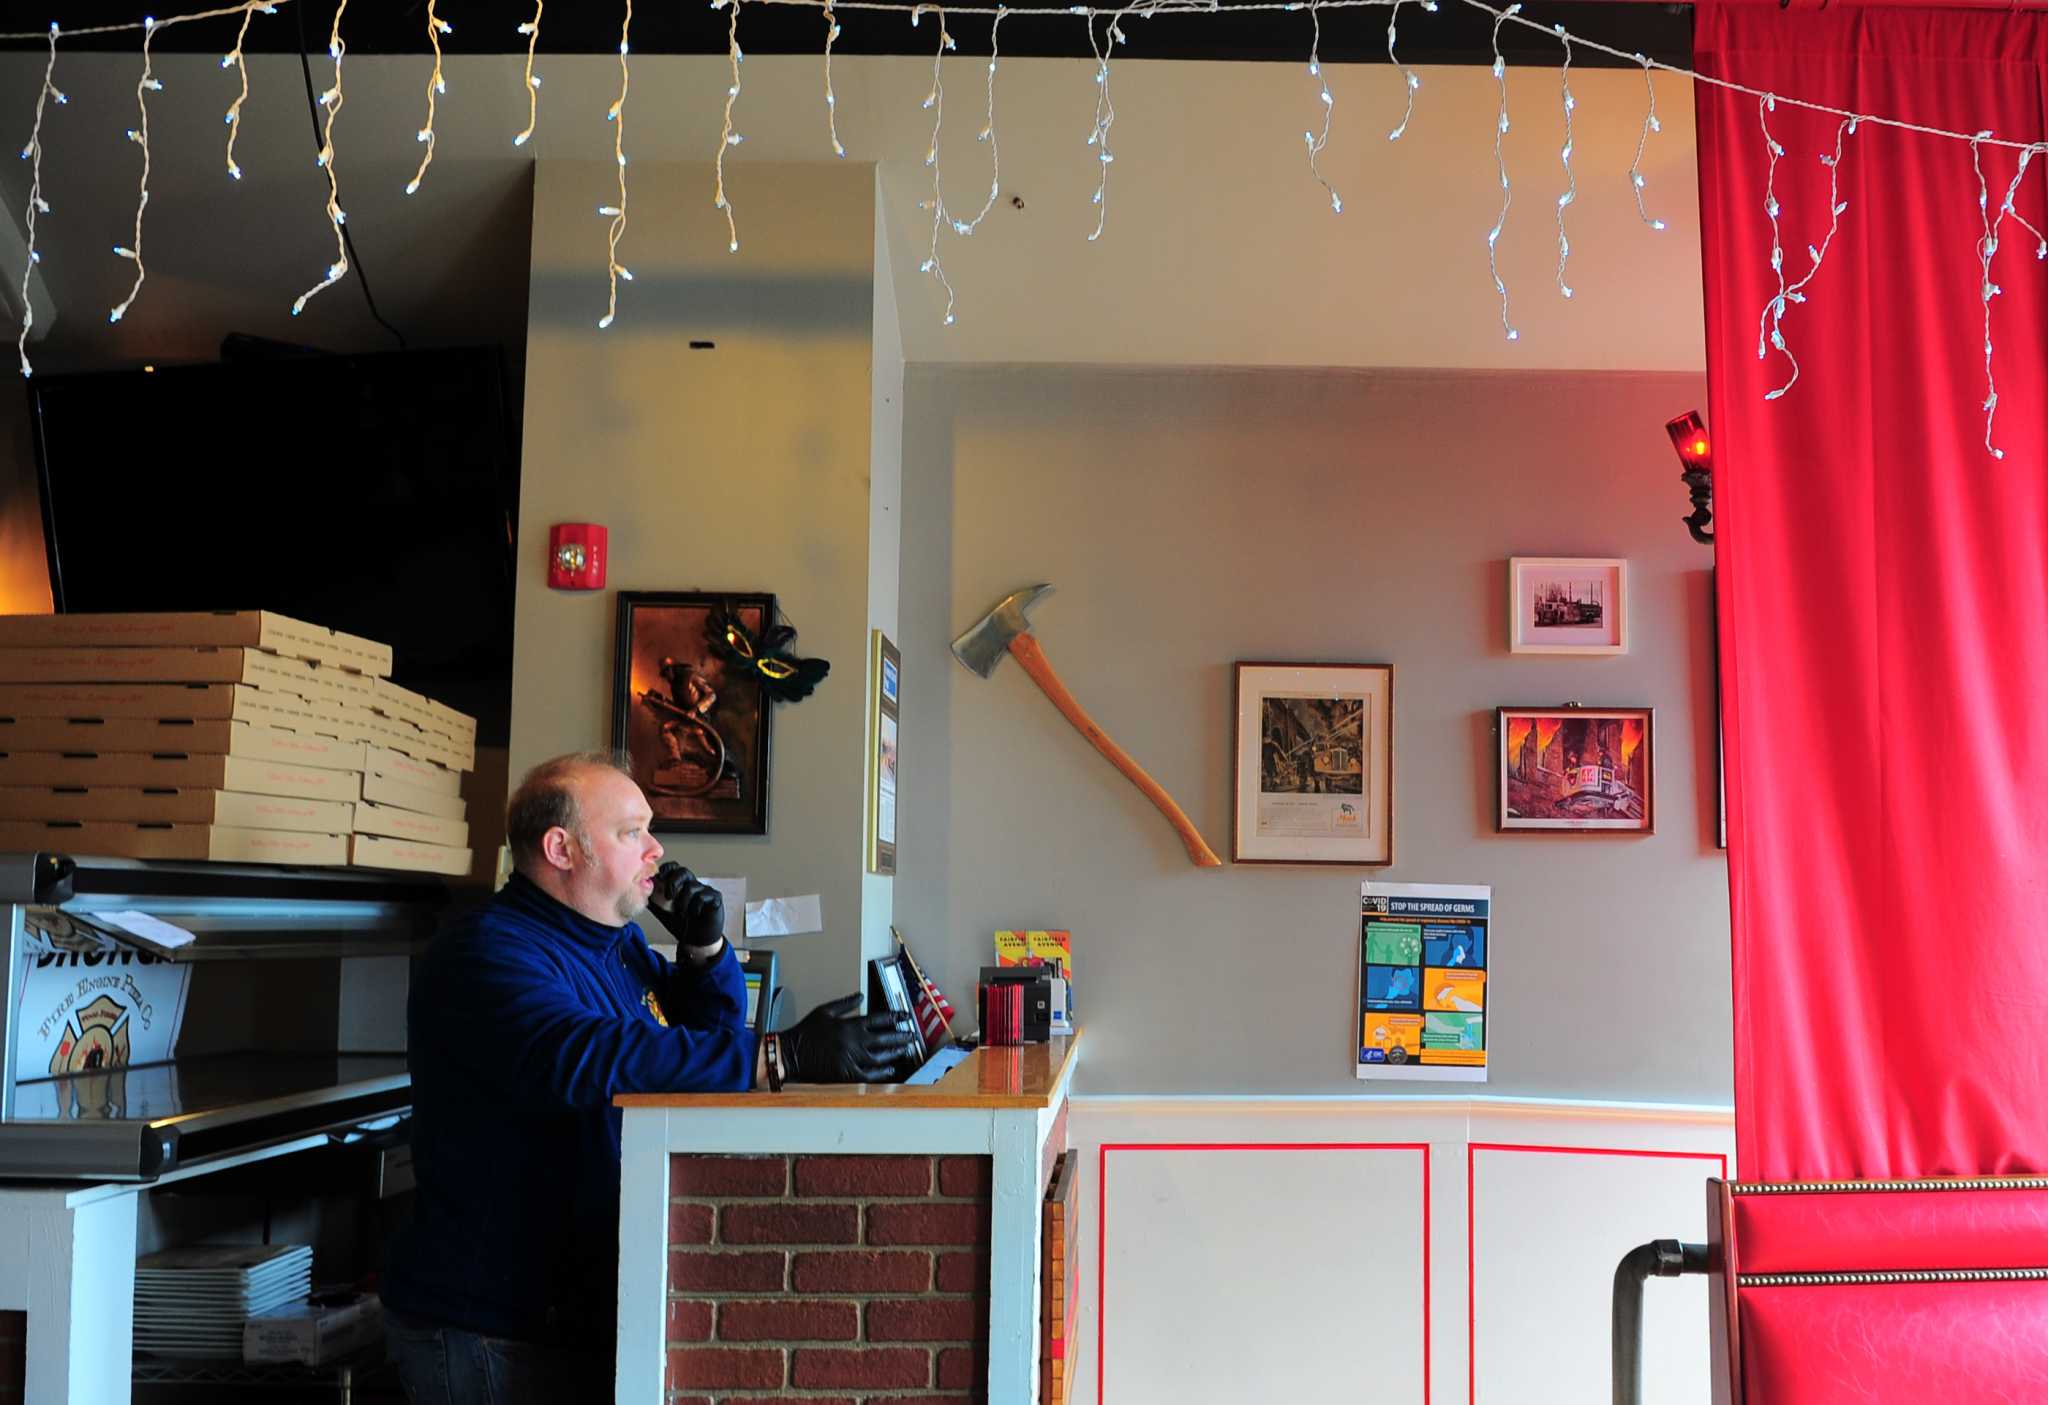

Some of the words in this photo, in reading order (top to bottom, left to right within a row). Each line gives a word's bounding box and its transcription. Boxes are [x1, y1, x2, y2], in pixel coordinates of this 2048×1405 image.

[1377, 904, 1387, 912] 19
[1390, 902, 1407, 911] STOP
[1407, 902, 1420, 911] THE
[1420, 903, 1443, 912] SPREAD
[1444, 903, 1453, 912] OF
[1453, 904, 1475, 913] GERMS
